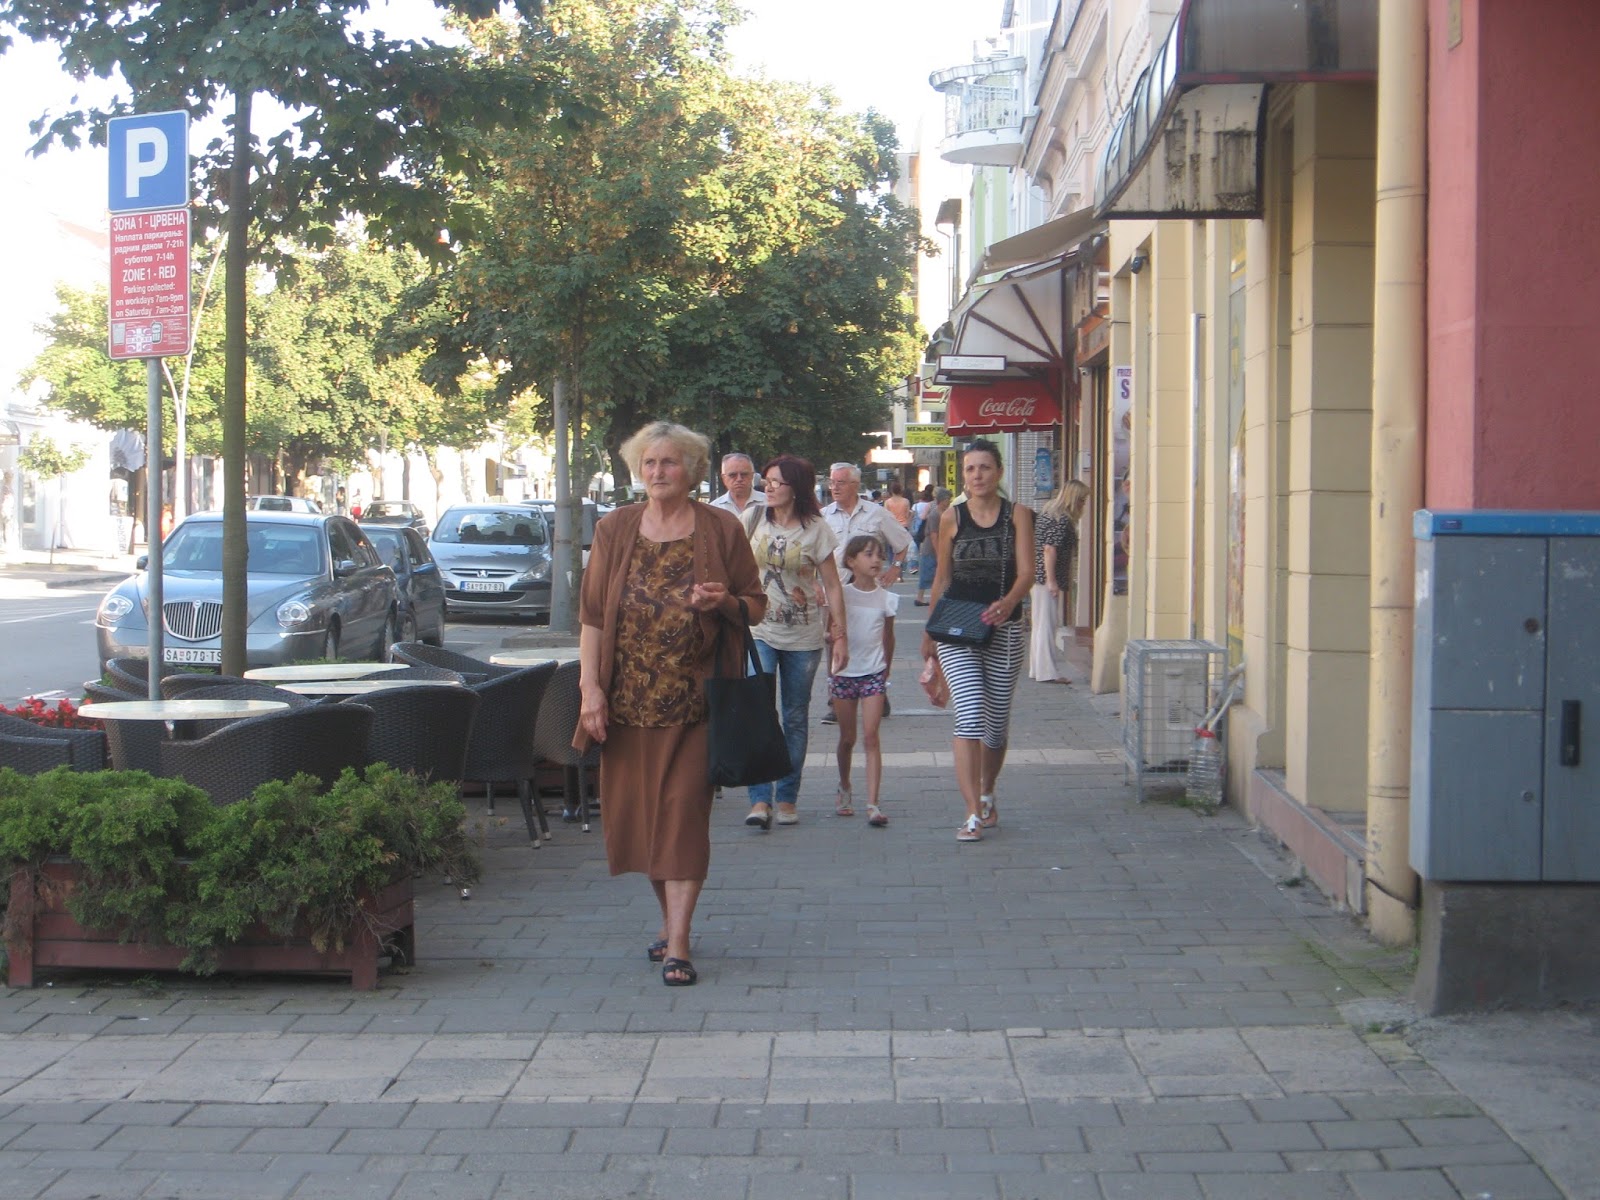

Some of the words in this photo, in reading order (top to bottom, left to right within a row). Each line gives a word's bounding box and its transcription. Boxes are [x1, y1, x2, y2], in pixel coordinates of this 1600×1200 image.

[126, 127, 168, 198] P
[113, 217, 136, 231] ЗОНА
[138, 216, 143, 229] 1
[150, 212, 185, 230] ЦРВЕНА
[166, 239, 184, 248] 7-21h
[156, 252, 175, 261] 7-14h
[122, 268, 146, 282] ZONE
[147, 268, 151, 280] 1
[158, 265, 176, 279] RED
[123, 285, 146, 294] Parking
[125, 296, 154, 305] workdays
[125, 307, 152, 317] Saturday
[166, 650, 178, 661] SA
